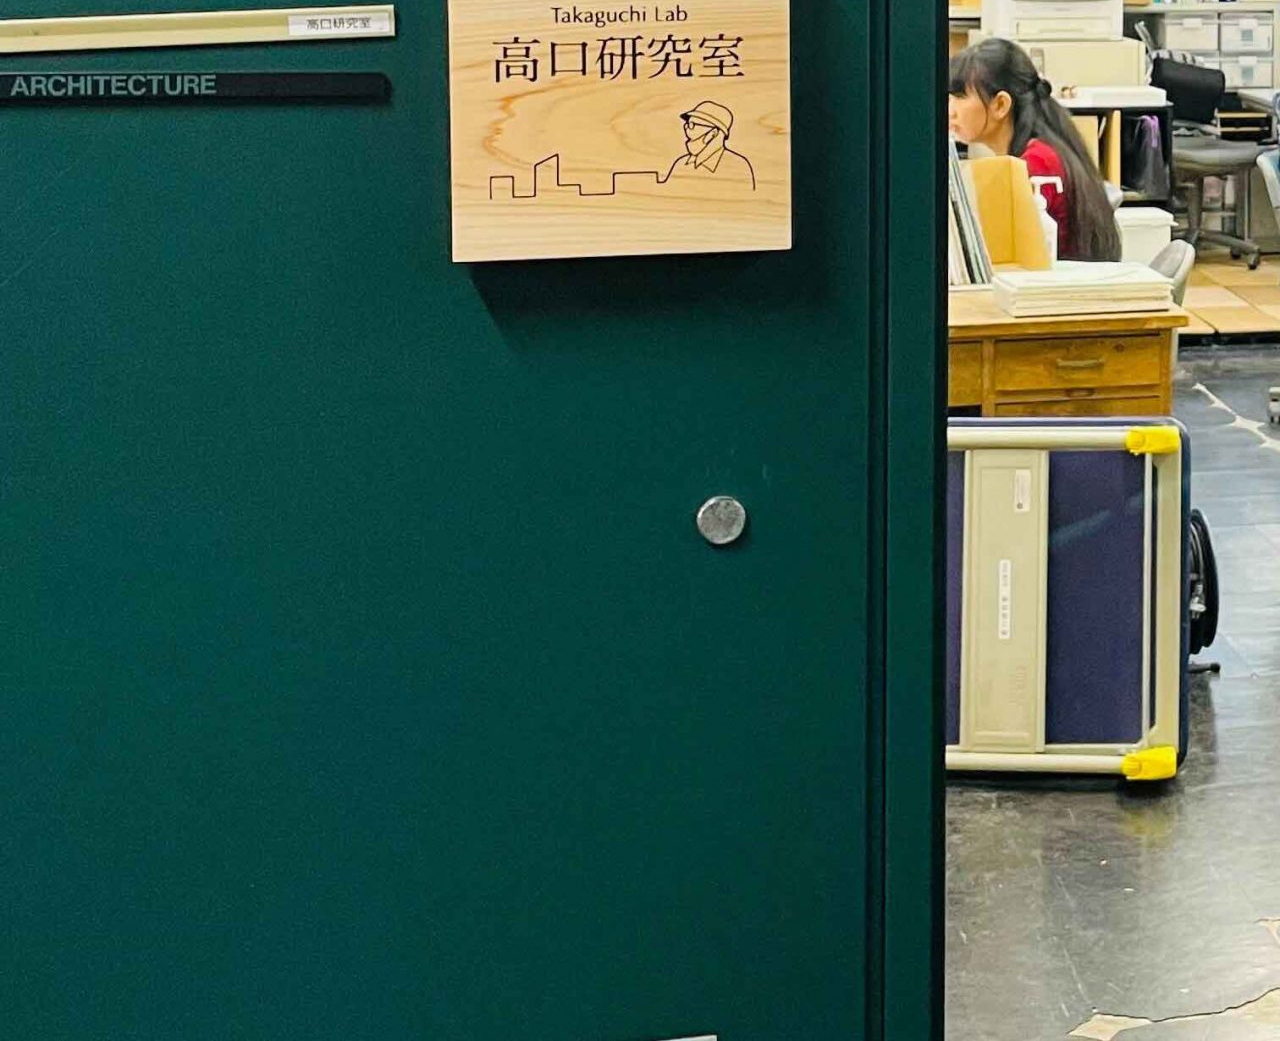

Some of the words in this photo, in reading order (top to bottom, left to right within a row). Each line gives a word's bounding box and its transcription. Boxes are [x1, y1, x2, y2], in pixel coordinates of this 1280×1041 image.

[305, 16, 372, 31] 高口研究室
[550, 4, 647, 28] Takaguchi
[655, 4, 688, 23] Lab
[492, 33, 745, 84] 高口研究室
[10, 73, 217, 97] ARCHITECTURE
